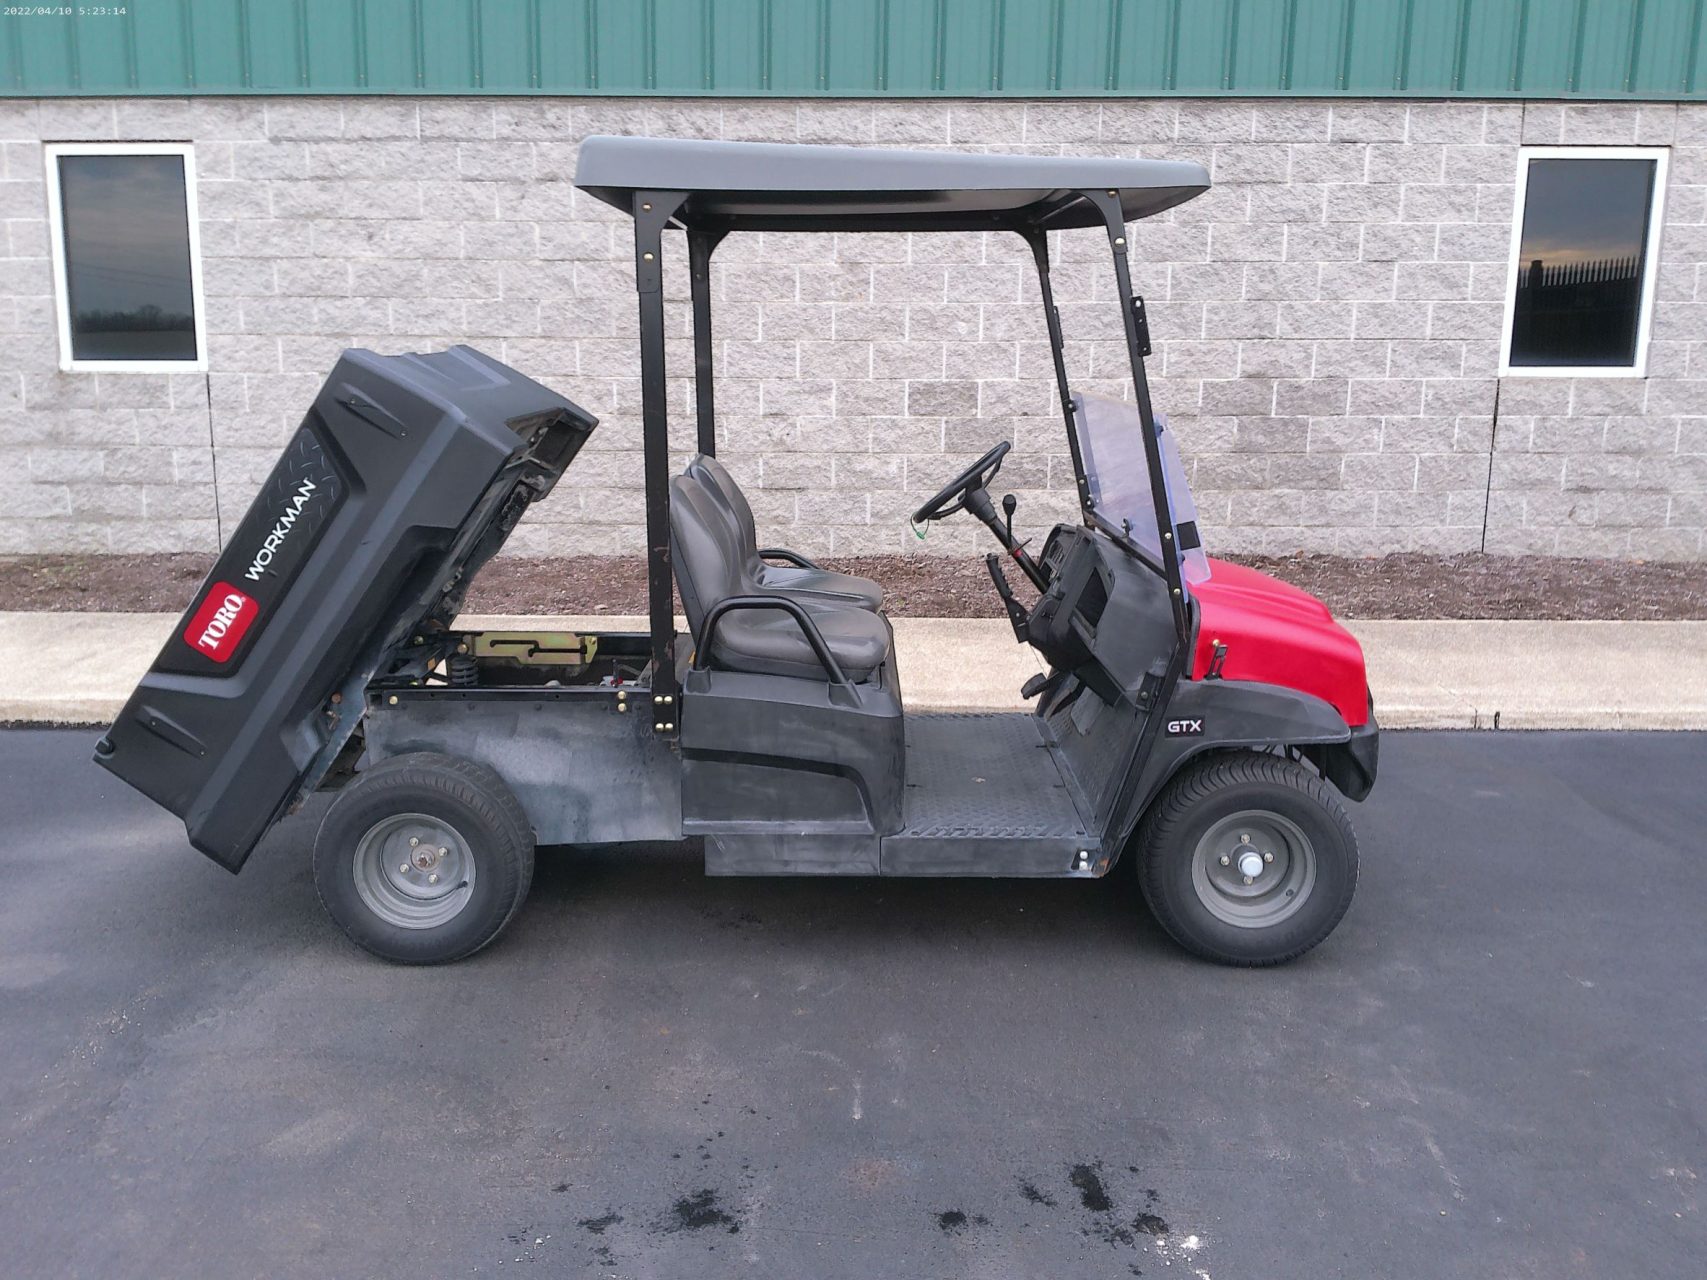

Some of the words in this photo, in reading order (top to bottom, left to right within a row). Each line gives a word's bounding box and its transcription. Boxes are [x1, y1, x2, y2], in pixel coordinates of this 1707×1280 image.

[245, 477, 316, 581] WORKMAN
[198, 594, 244, 650] TORO
[1167, 719, 1202, 733] GTX
